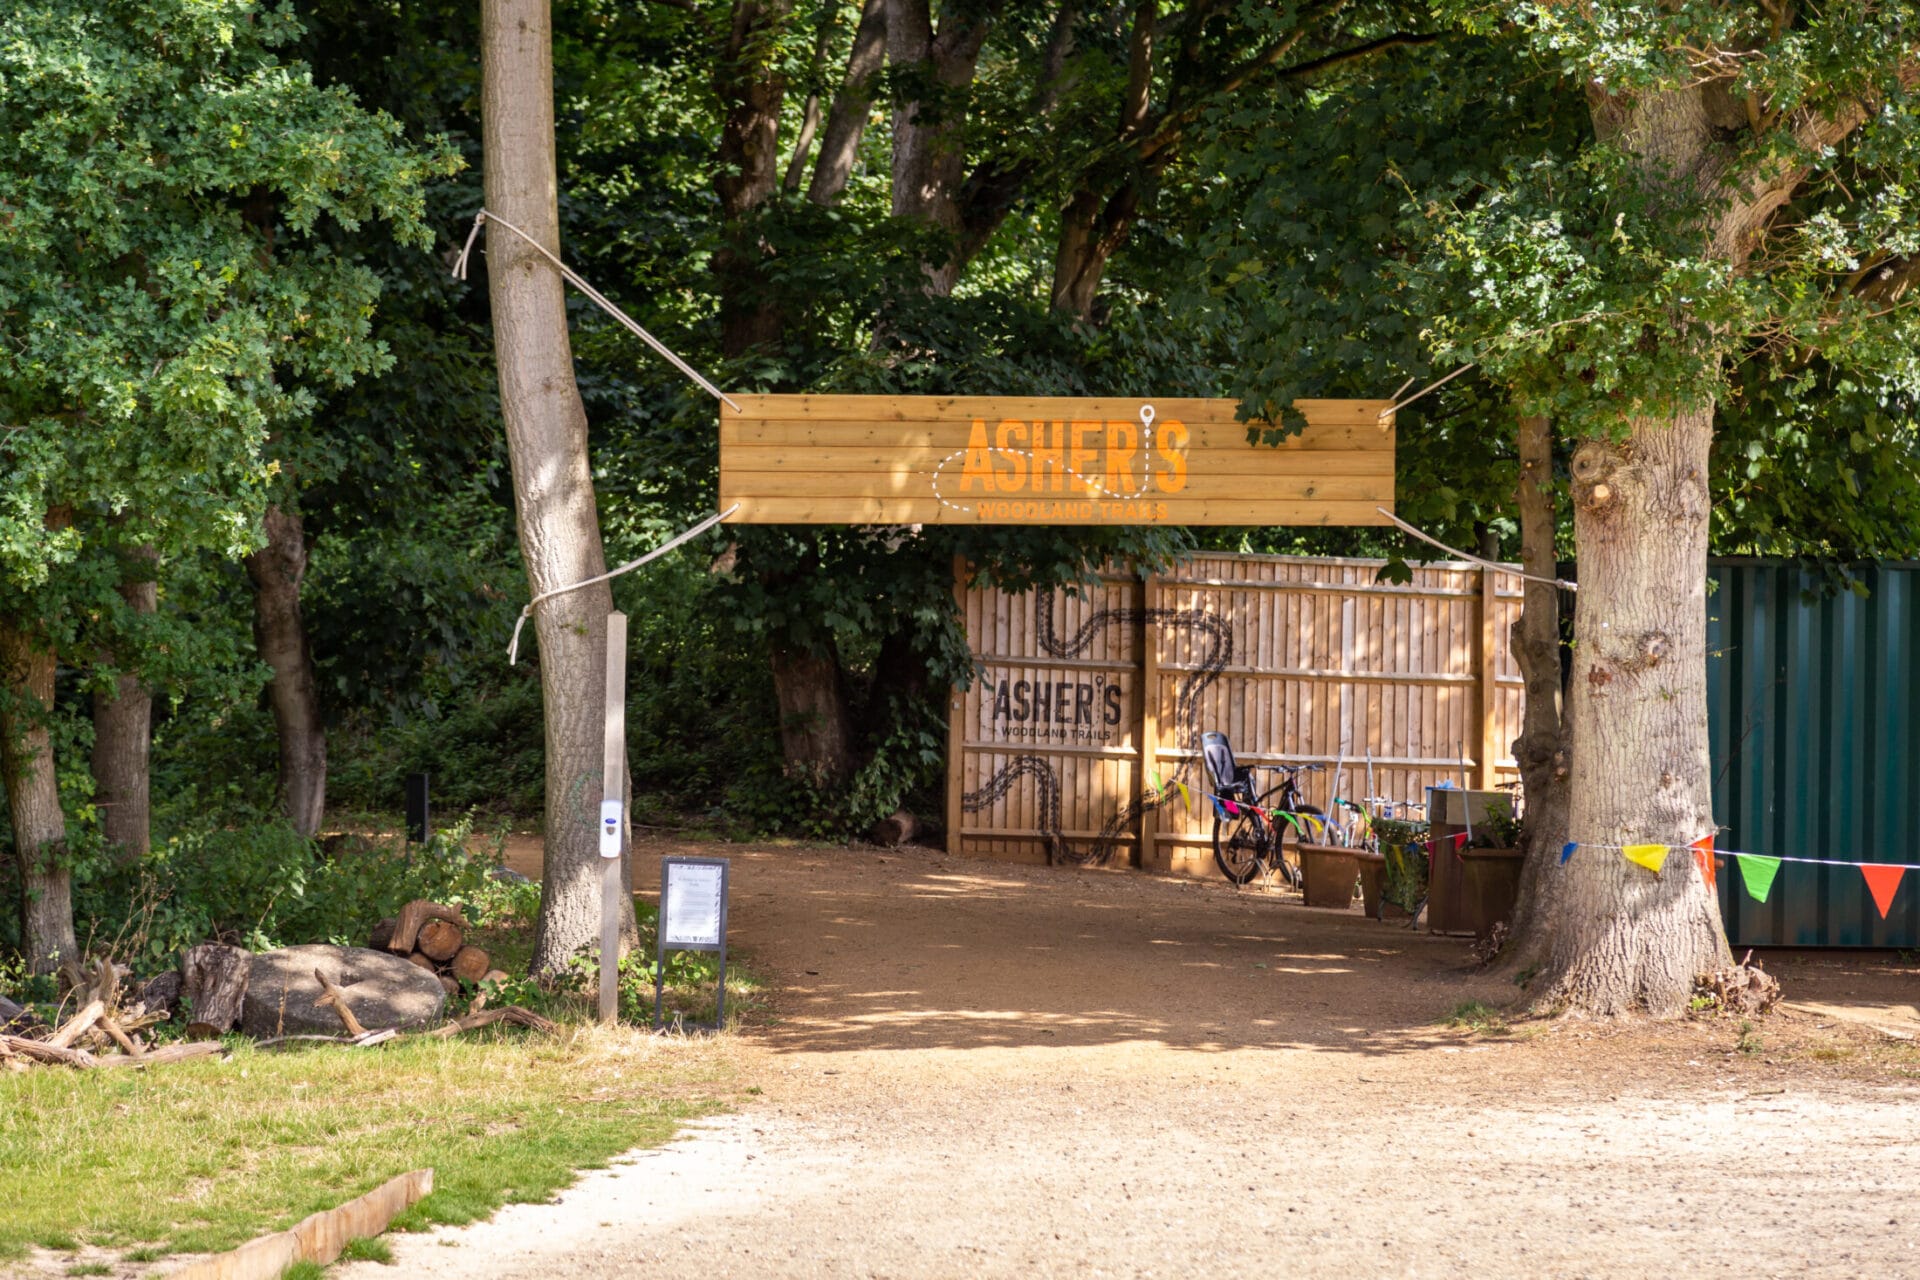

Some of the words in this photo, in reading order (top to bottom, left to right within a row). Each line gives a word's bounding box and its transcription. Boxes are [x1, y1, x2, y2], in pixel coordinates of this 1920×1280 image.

[959, 417, 1188, 494] ASHER'S
[977, 501, 1093, 520] WOODLAND
[1099, 502, 1168, 520] TRAILS
[993, 678, 1122, 726] ASHER'S
[1001, 726, 1067, 739] WOODLAND
[1070, 729, 1111, 740] TRAILS
